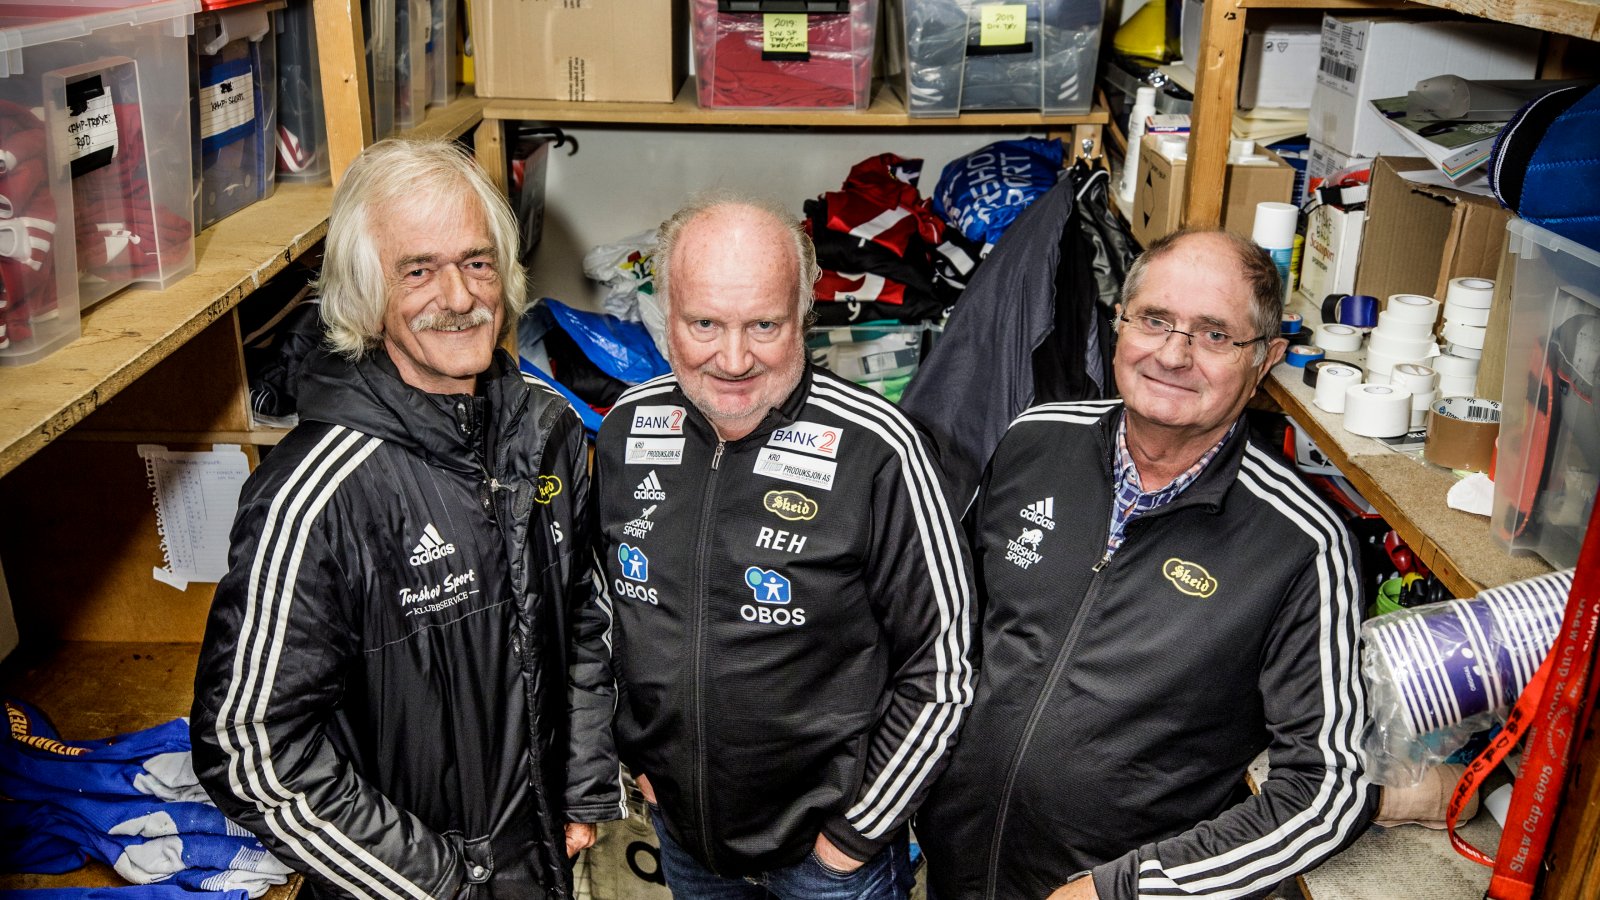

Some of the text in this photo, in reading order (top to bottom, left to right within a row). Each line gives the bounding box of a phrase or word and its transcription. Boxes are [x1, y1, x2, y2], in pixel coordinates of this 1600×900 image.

[634, 441, 645, 449] KRO
[647, 450, 674, 458] PRODUKSJON
[768, 453, 781, 462] KRO
[783, 464, 821, 480] PRODUKSJON
[822, 474, 832, 483] AS
[634, 489, 666, 501] adidas
[771, 494, 810, 516] Skeid
[1020, 507, 1056, 531] adidas
[623, 525, 648, 540] SPORT
[755, 526, 808, 554] REH
[409, 542, 456, 567] adidas
[1005, 550, 1033, 570] SPORT
[1006, 539, 1043, 564] TORSHOV
[400, 569, 475, 607] Torshov Sport
[1170, 564, 1210, 592] Skeid
[615, 578, 659, 606] OBOS
[740, 604, 806, 626] OBOS
[1510, 834, 1533, 873] Skaw
[1522, 803, 1544, 834] Cup
[1534, 765, 1553, 803] 2005
